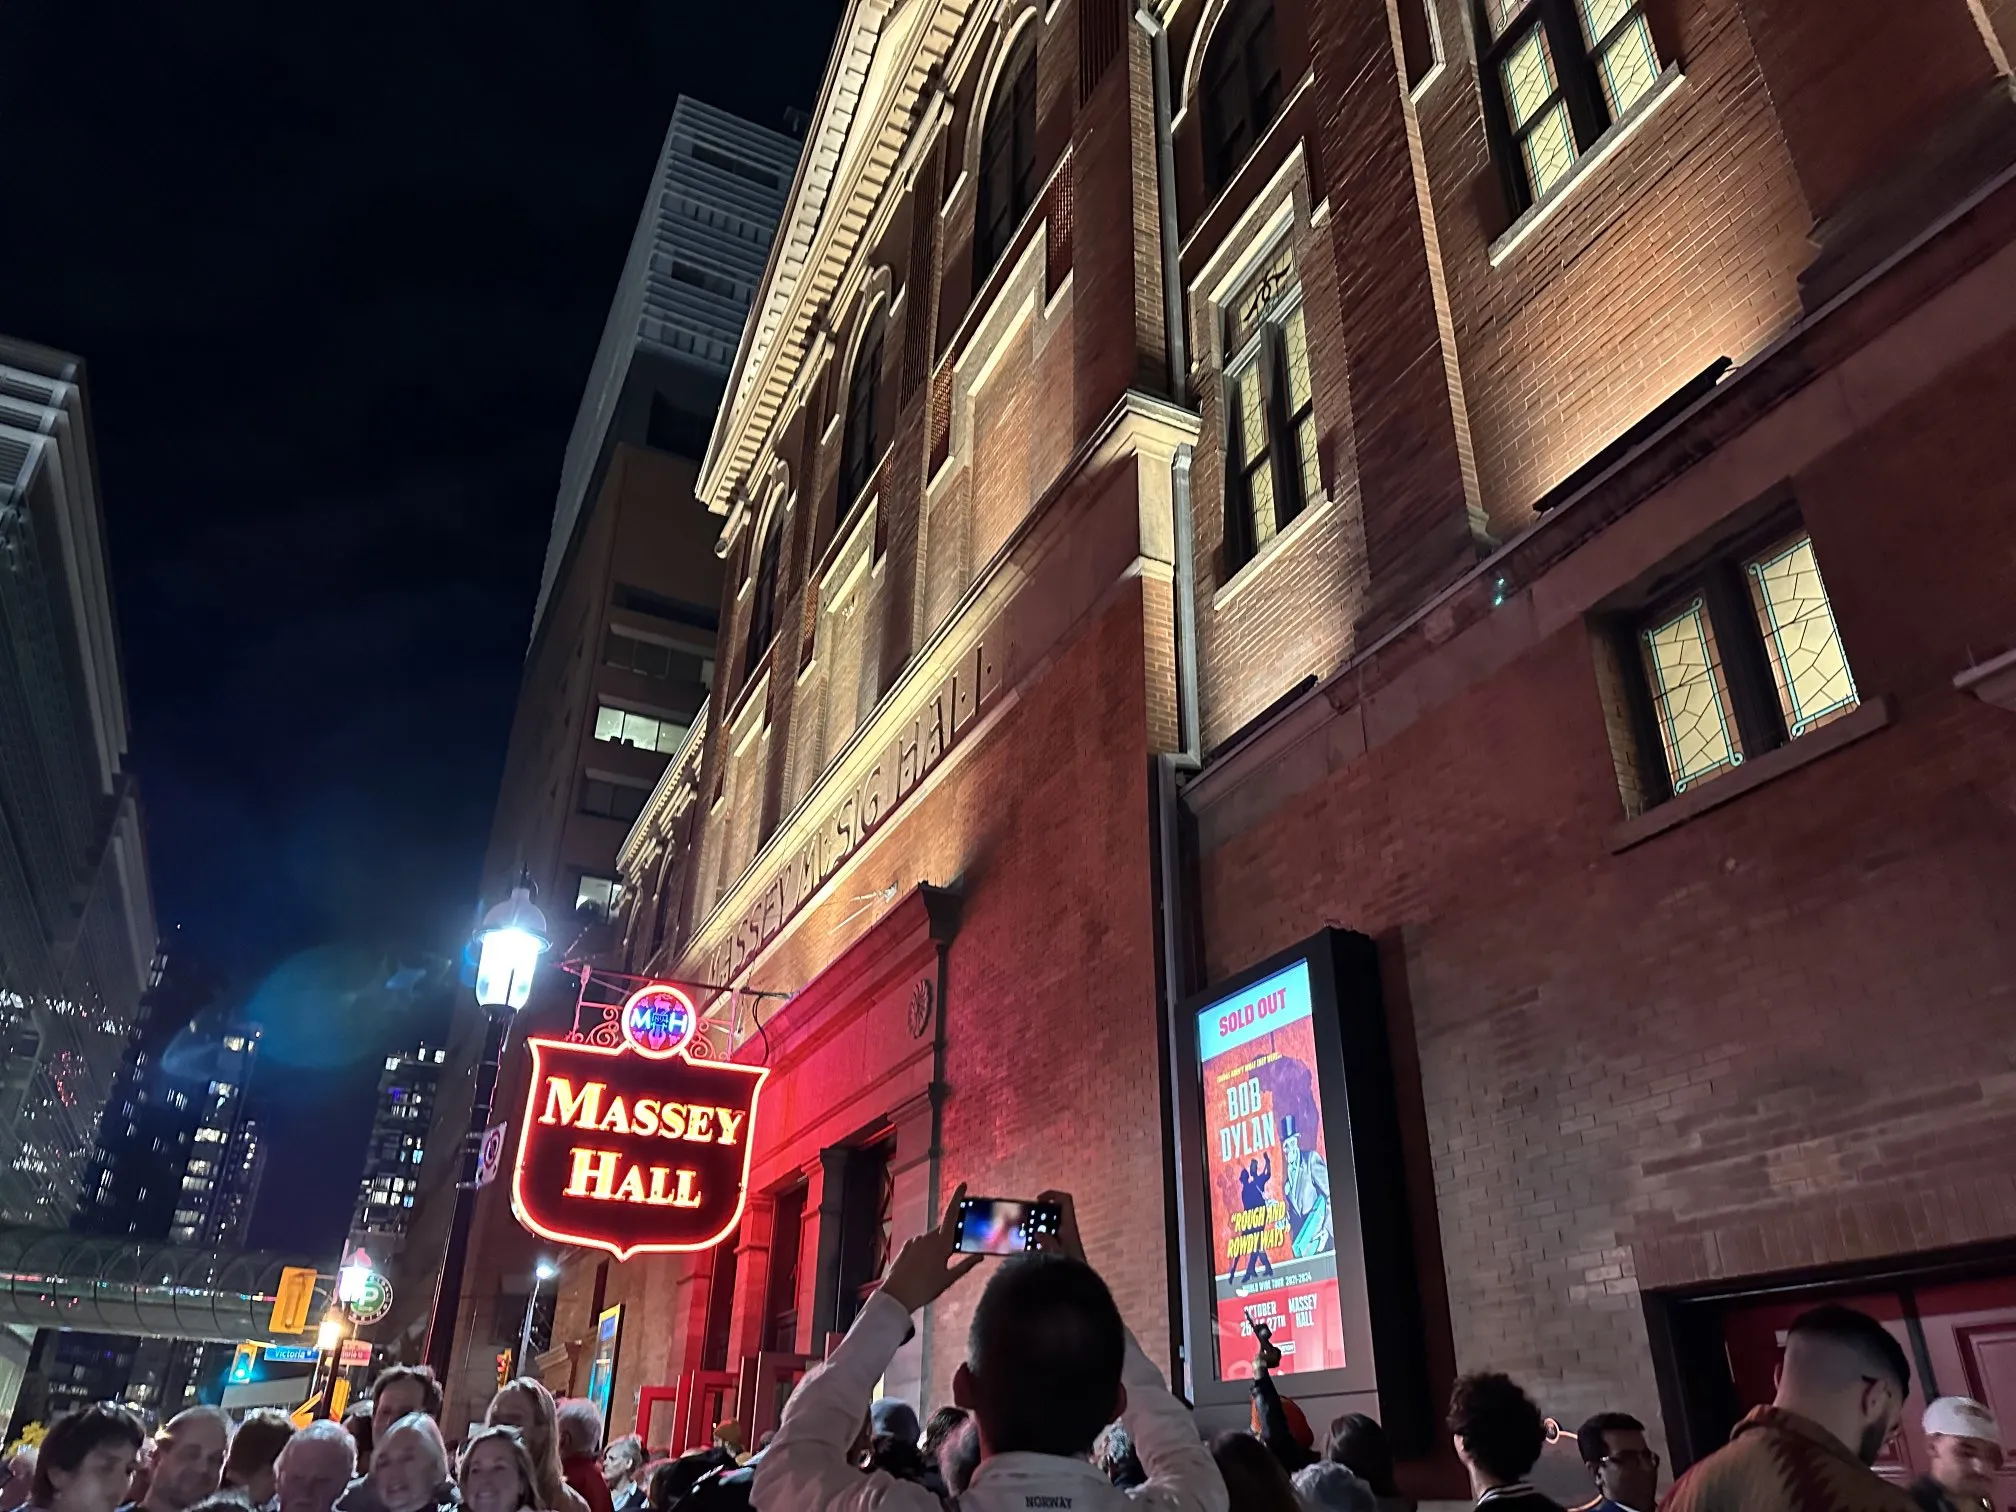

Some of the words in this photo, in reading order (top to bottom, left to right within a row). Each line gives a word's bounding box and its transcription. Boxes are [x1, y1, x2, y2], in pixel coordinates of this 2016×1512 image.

[898, 641, 1003, 800] HALL
[1219, 1004, 1254, 1037] SOLD
[1257, 988, 1286, 1019] OUT
[1227, 1076, 1261, 1121] BOB
[1219, 1111, 1275, 1163] DYLAN
[1265, 1200, 1286, 1222] AND
[1227, 1231, 1260, 1259] ROWDY
[1243, 1301, 1277, 1319] OCTOBER
[1288, 1293, 1317, 1314] MASSEY
[1295, 1311, 1314, 1328] HALL
[275, 1347, 306, 1359] Victoria
[1025, 1496, 1072, 1509] NORWAY
